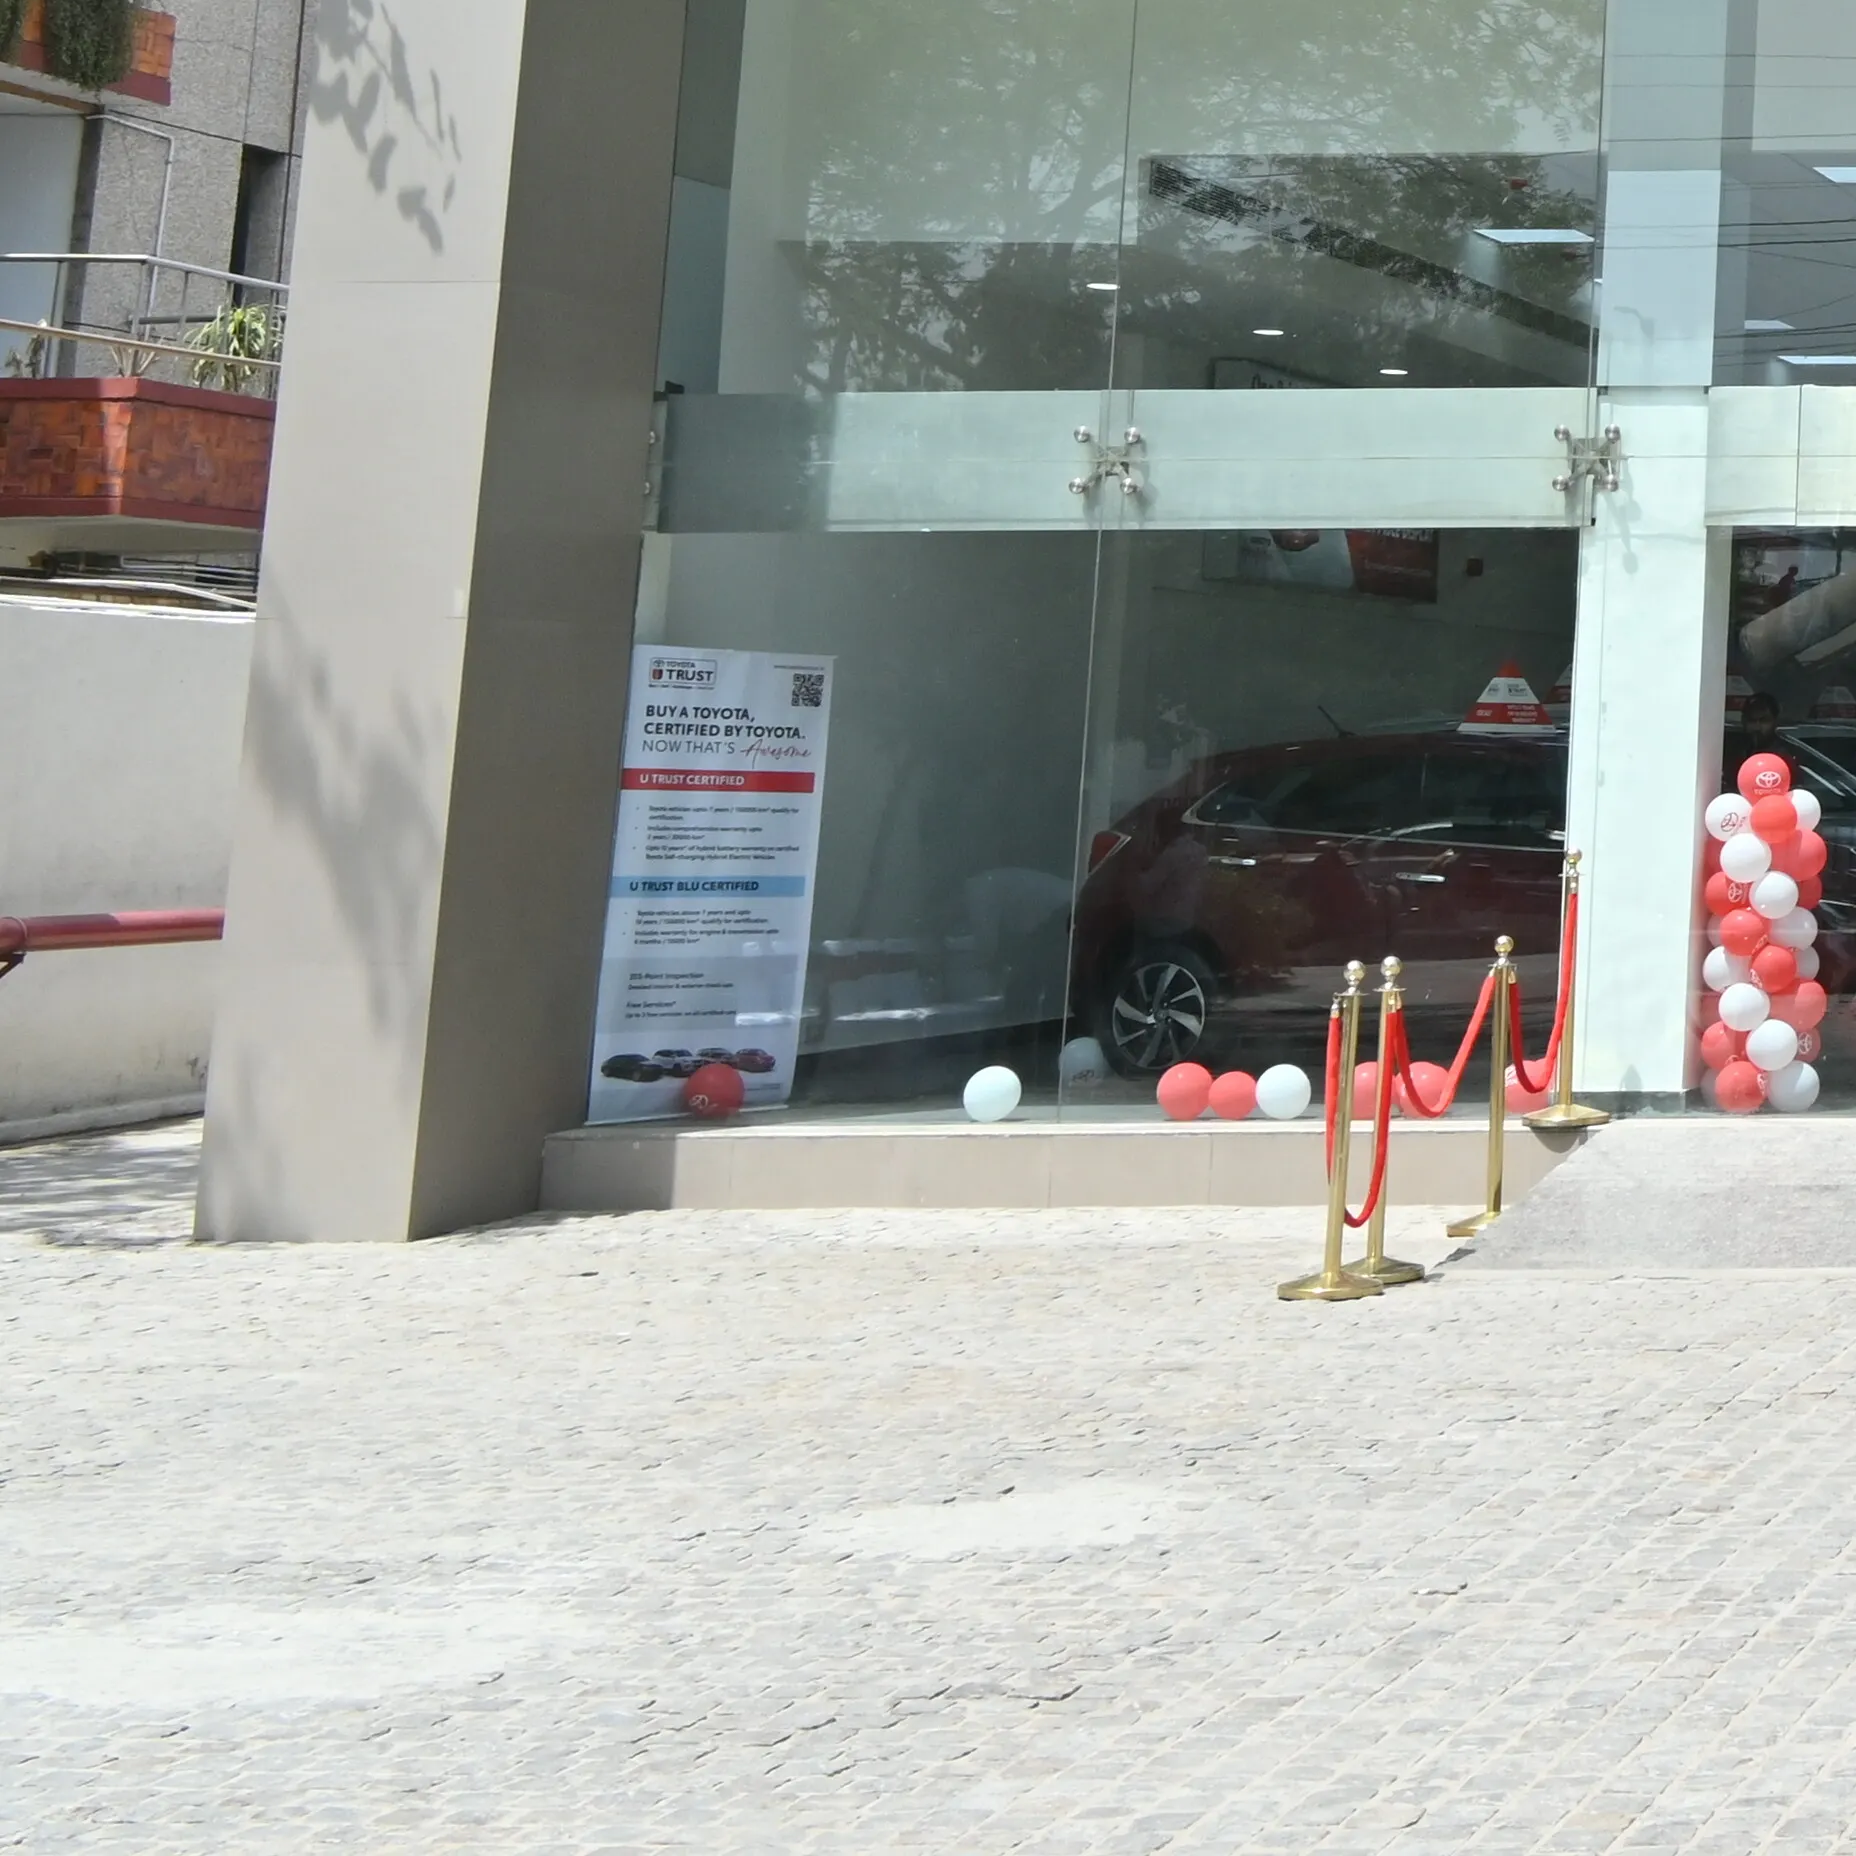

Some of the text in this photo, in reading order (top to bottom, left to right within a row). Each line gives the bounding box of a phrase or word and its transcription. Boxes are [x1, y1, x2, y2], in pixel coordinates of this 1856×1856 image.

[666, 668, 714, 682] TRUST
[645, 705, 756, 722] BUY A TOYOTA,
[644, 722, 807, 740] CERTIFIED BY TOYOTA.
[641, 740, 686, 753] NOW
[686, 741, 736, 755] THAT'S
[639, 773, 745, 786] U TRUST CERTIFIED
[629, 880, 759, 892] U TRUST BLU CERTIFIED
